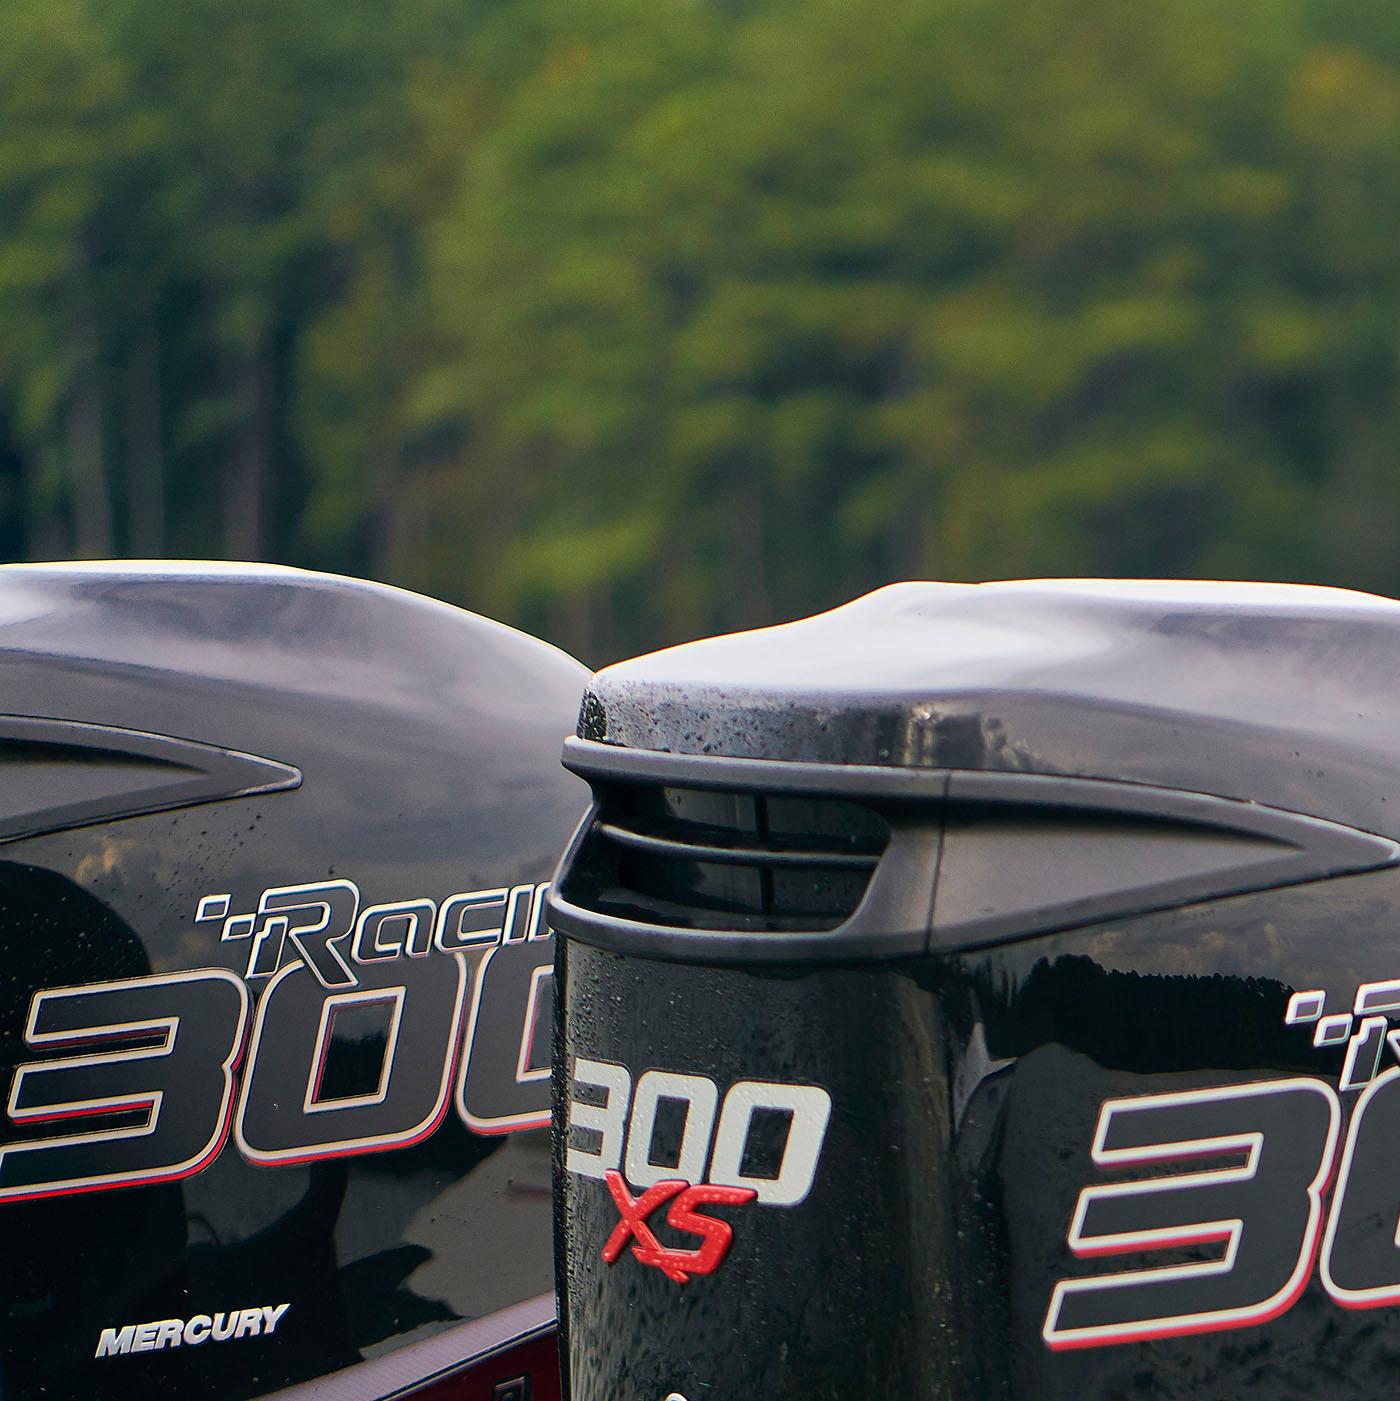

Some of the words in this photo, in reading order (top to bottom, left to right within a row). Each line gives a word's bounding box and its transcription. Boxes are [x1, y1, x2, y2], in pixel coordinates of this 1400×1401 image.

[566, 1056, 832, 1207] 300
[601, 1167, 758, 1285] XS
[95, 1303, 290, 1359] MERCURY
